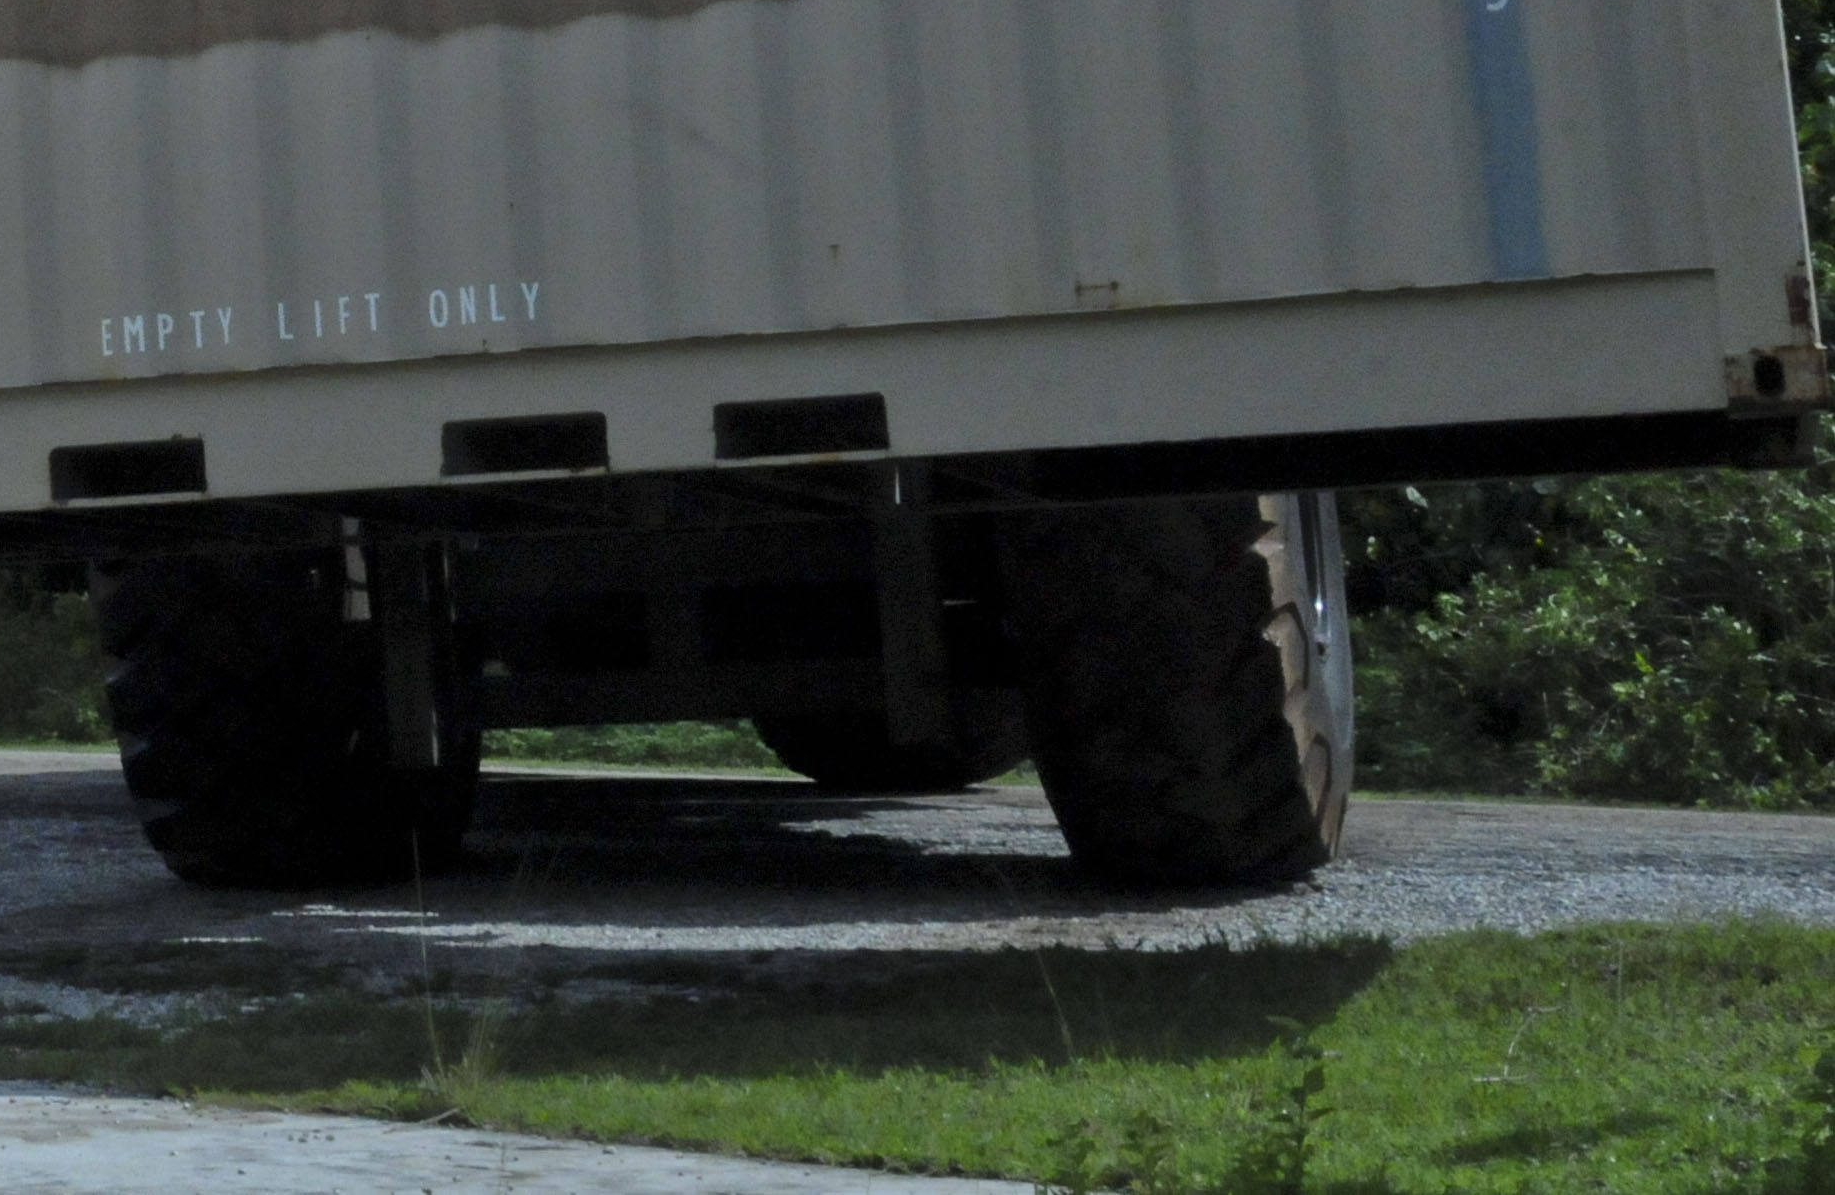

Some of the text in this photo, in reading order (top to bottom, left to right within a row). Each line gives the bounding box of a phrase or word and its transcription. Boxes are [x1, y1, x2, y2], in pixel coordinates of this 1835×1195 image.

[100, 281, 540, 357] EMPTY LIFT ONLY
